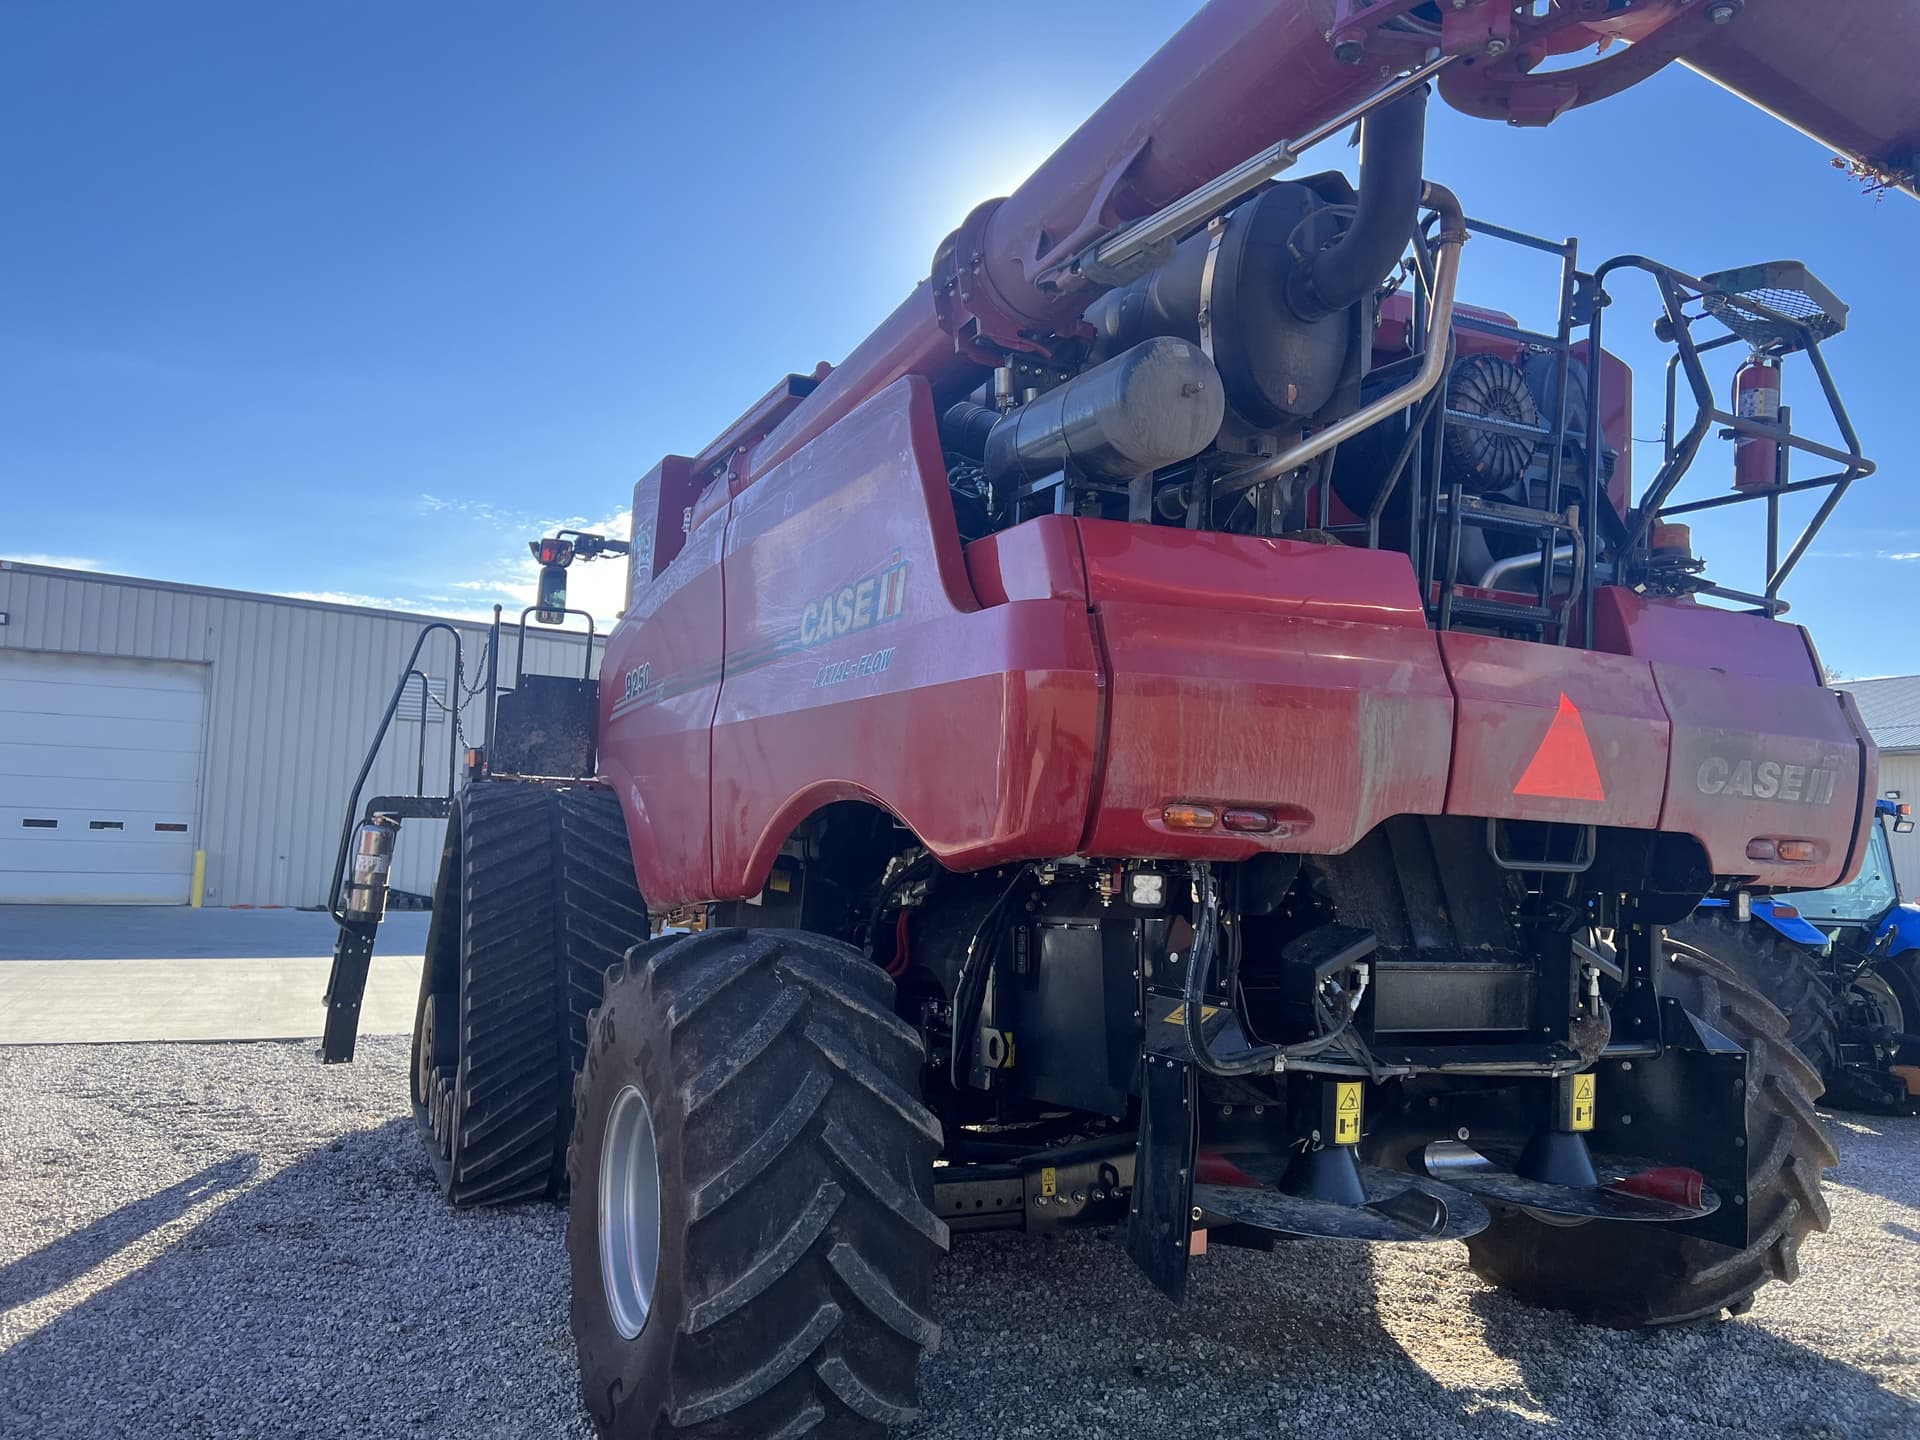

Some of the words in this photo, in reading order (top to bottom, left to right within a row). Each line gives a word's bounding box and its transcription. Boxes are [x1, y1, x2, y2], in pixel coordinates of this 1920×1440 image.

[800, 578, 875, 645] CASE
[625, 661, 650, 700] 9250
[1696, 756, 1806, 801] CASE
